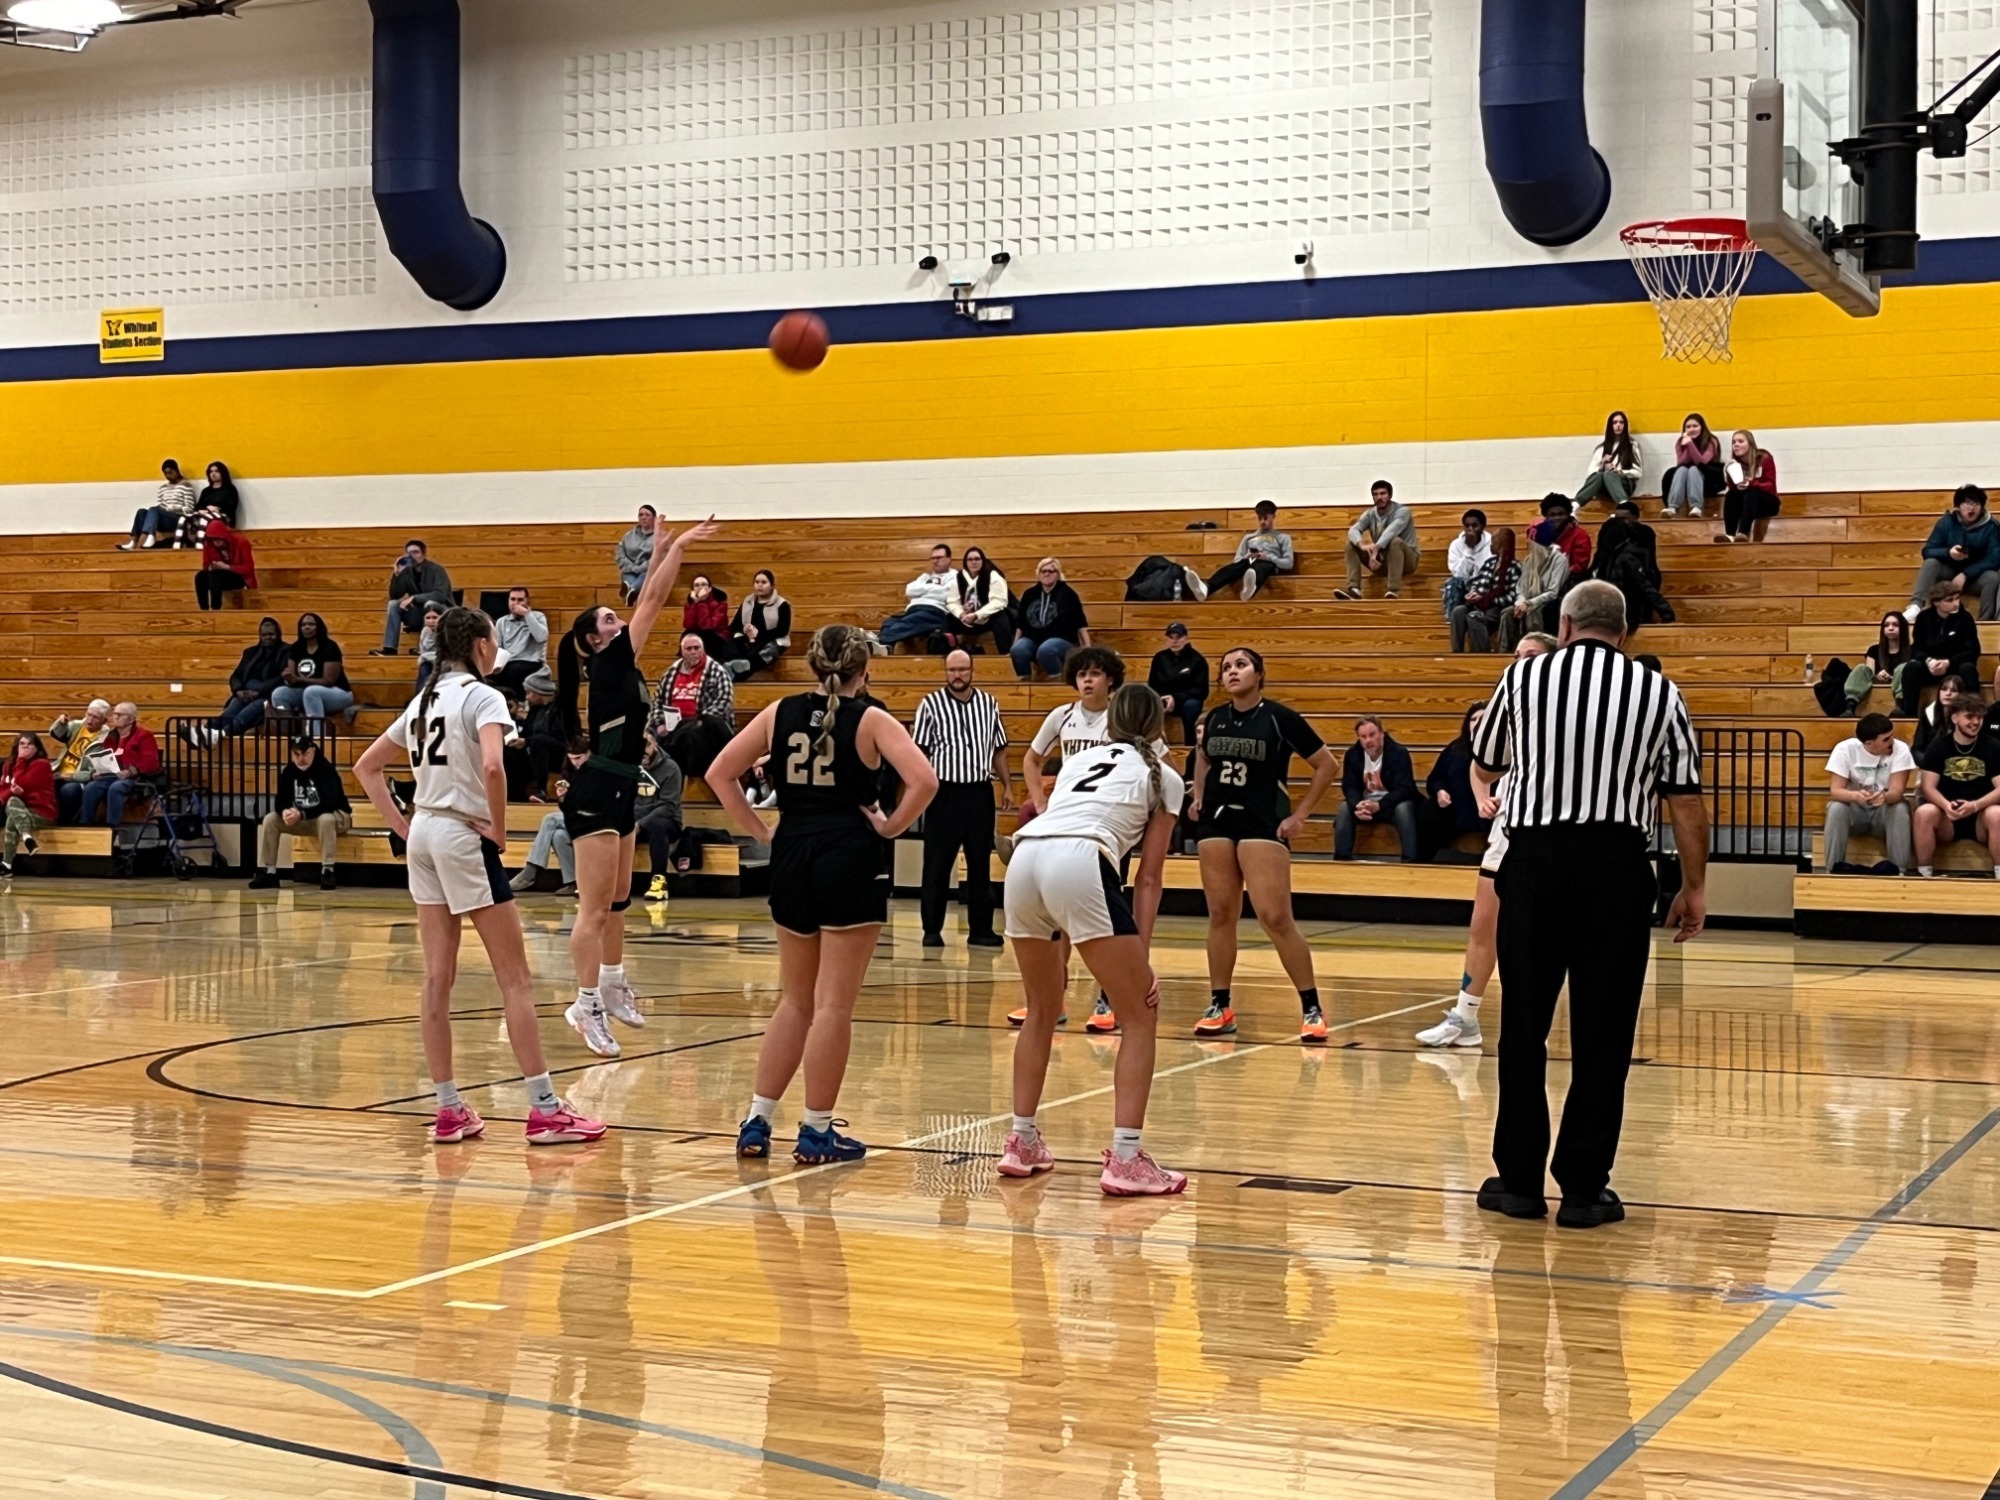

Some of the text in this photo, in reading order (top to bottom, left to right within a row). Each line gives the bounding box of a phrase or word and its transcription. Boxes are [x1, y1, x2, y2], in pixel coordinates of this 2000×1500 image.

[787, 732, 835, 786] 22
[1220, 760, 1247, 786] 23
[1071, 763, 1117, 792] 2
